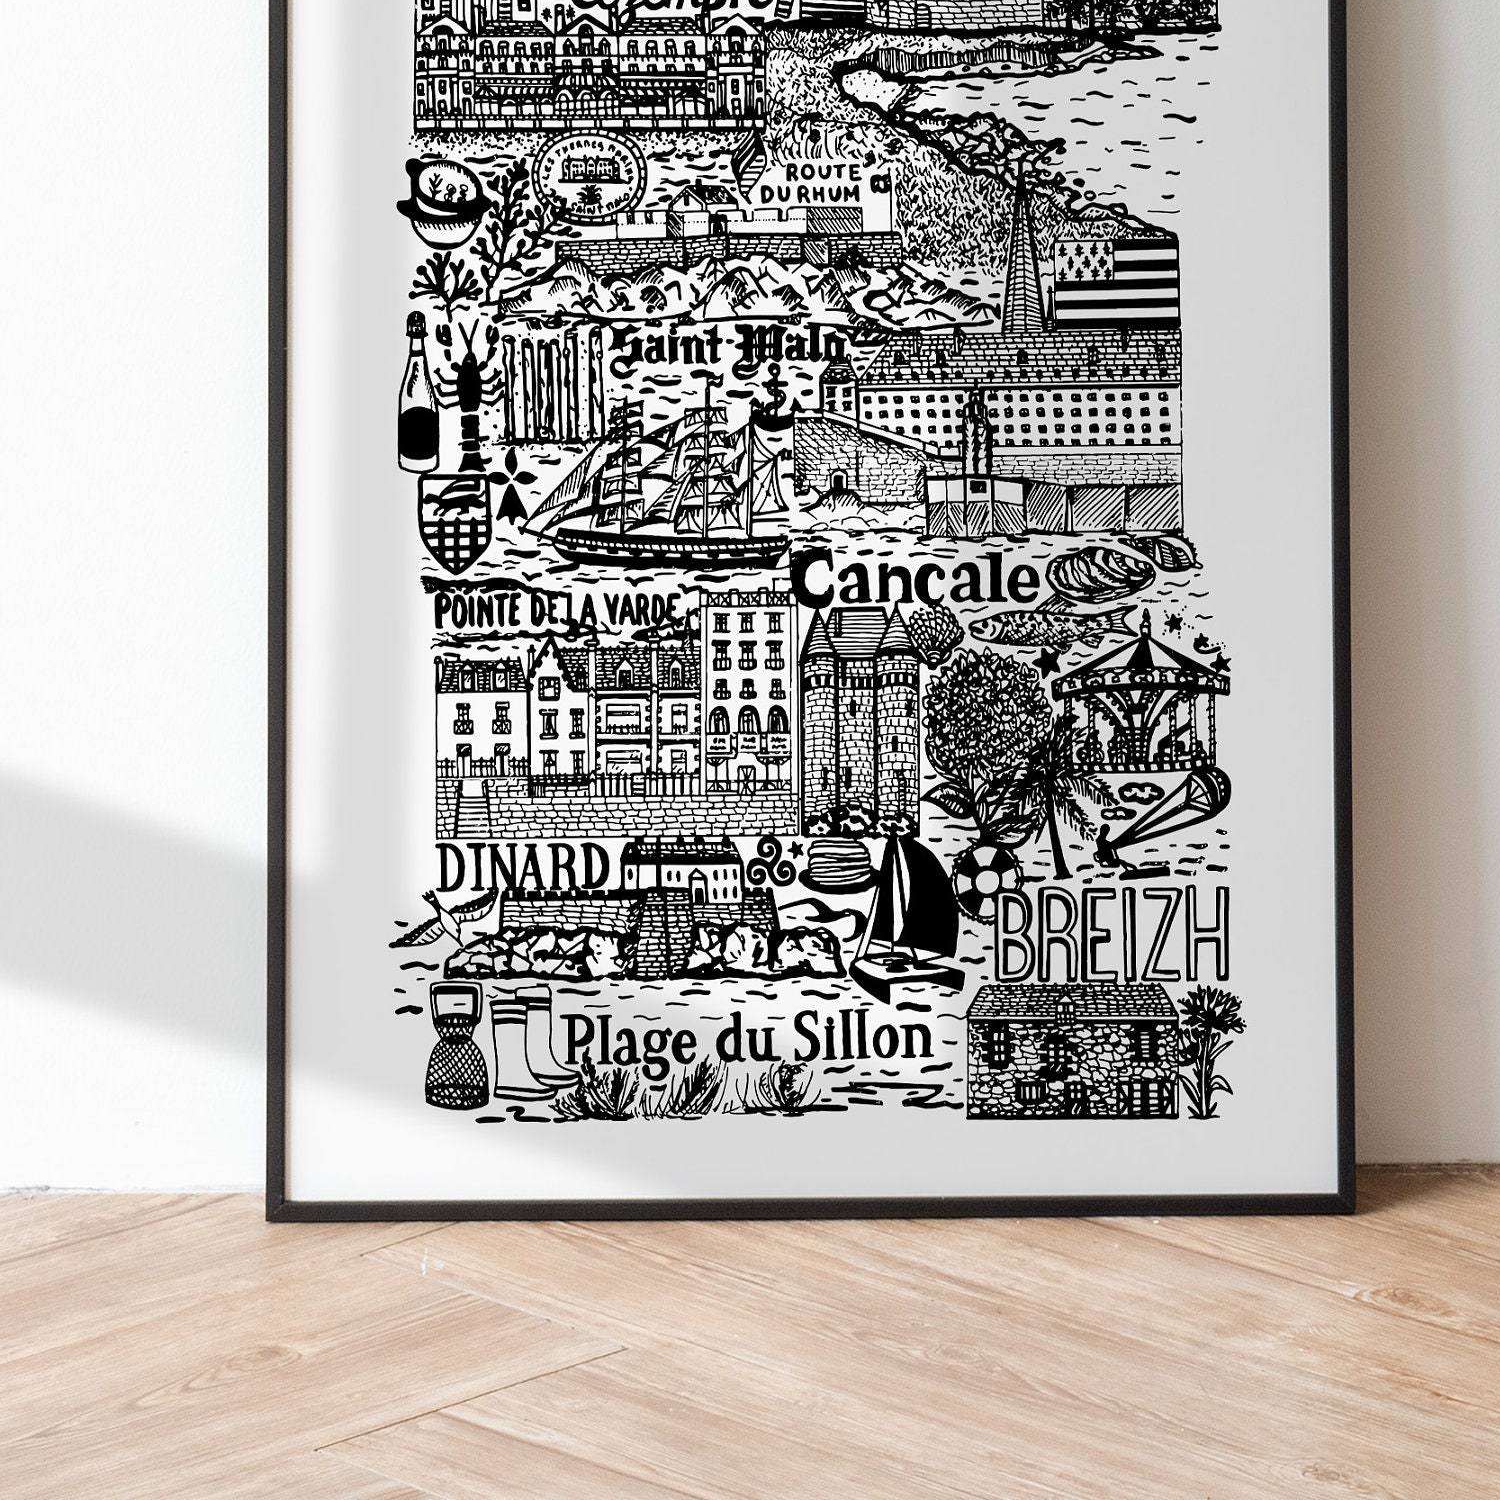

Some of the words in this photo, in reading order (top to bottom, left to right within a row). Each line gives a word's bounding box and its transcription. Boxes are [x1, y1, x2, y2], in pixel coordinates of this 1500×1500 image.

[760, 185, 791, 204] DU
[797, 184, 860, 203] RHUM
[786, 163, 863, 182] ROUTE
[790, 548, 1040, 610] Cancale
[434, 592, 522, 629] POINTE
[531, 592, 559, 627] DE
[603, 592, 682, 627] VARDE
[434, 842, 610, 893] DINARD
[994, 884, 1230, 982] BREIZH
[559, 1013, 697, 1081] Plage
[716, 1011, 782, 1062] du
[794, 1008, 935, 1063] Sillon
